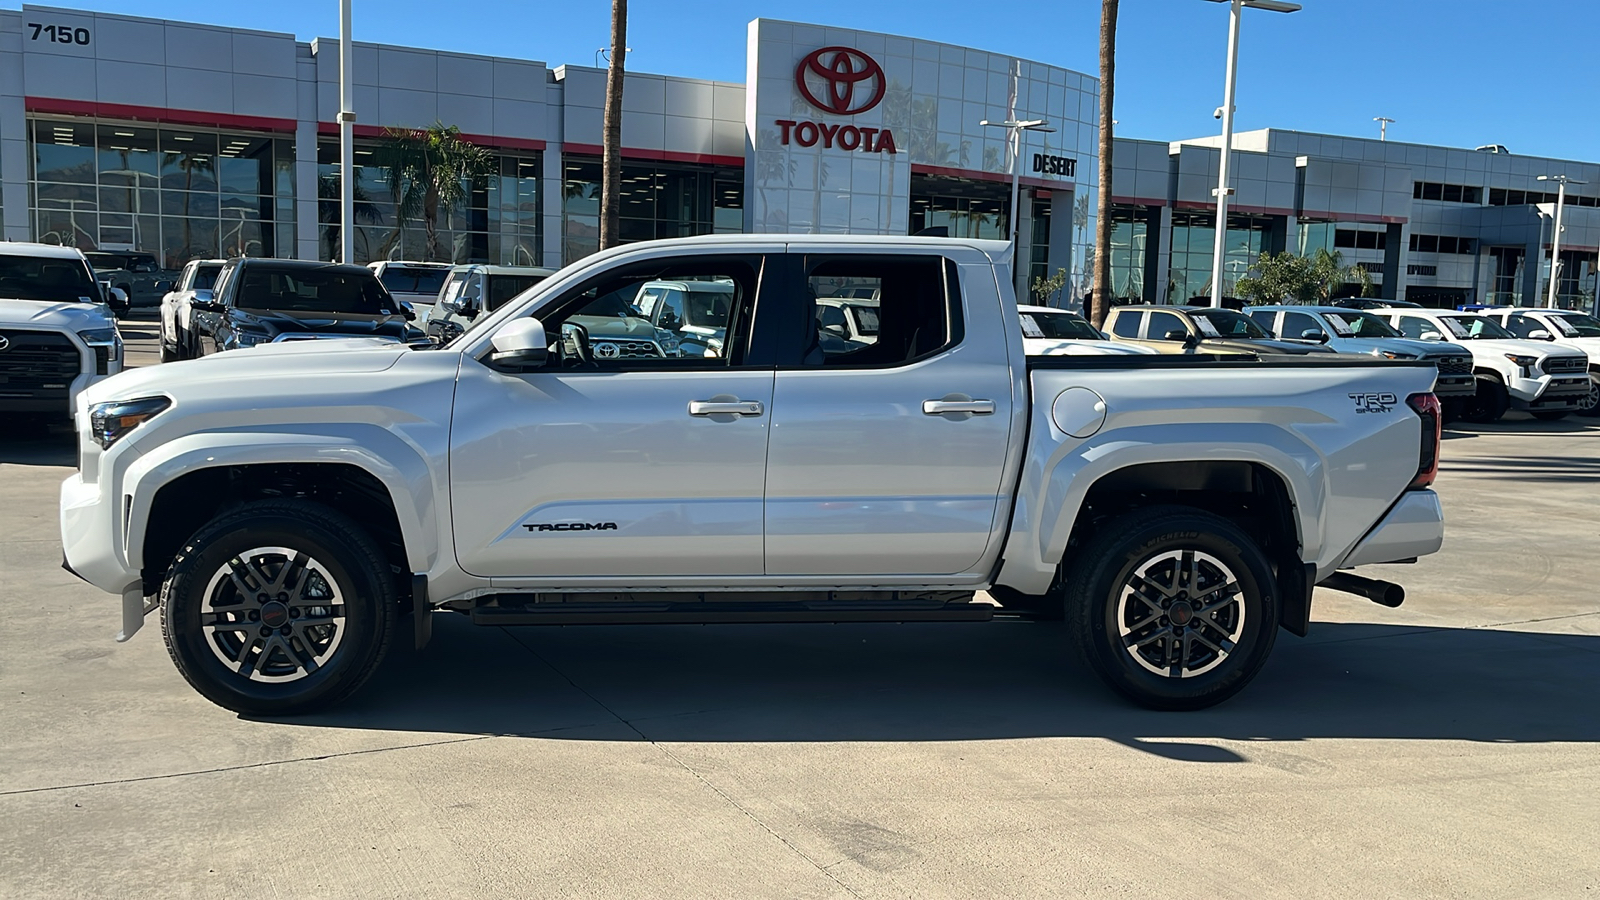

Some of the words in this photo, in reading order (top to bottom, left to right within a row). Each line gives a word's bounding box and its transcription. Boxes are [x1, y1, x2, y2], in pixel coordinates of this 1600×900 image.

[28, 22, 90, 46] 7150
[775, 119, 897, 154] TOYOTA
[1032, 153, 1077, 178] DESERT
[1348, 392, 1397, 408] TRD
[522, 522, 618, 532] TACOMA
[1147, 531, 1200, 547] MICHELIN
